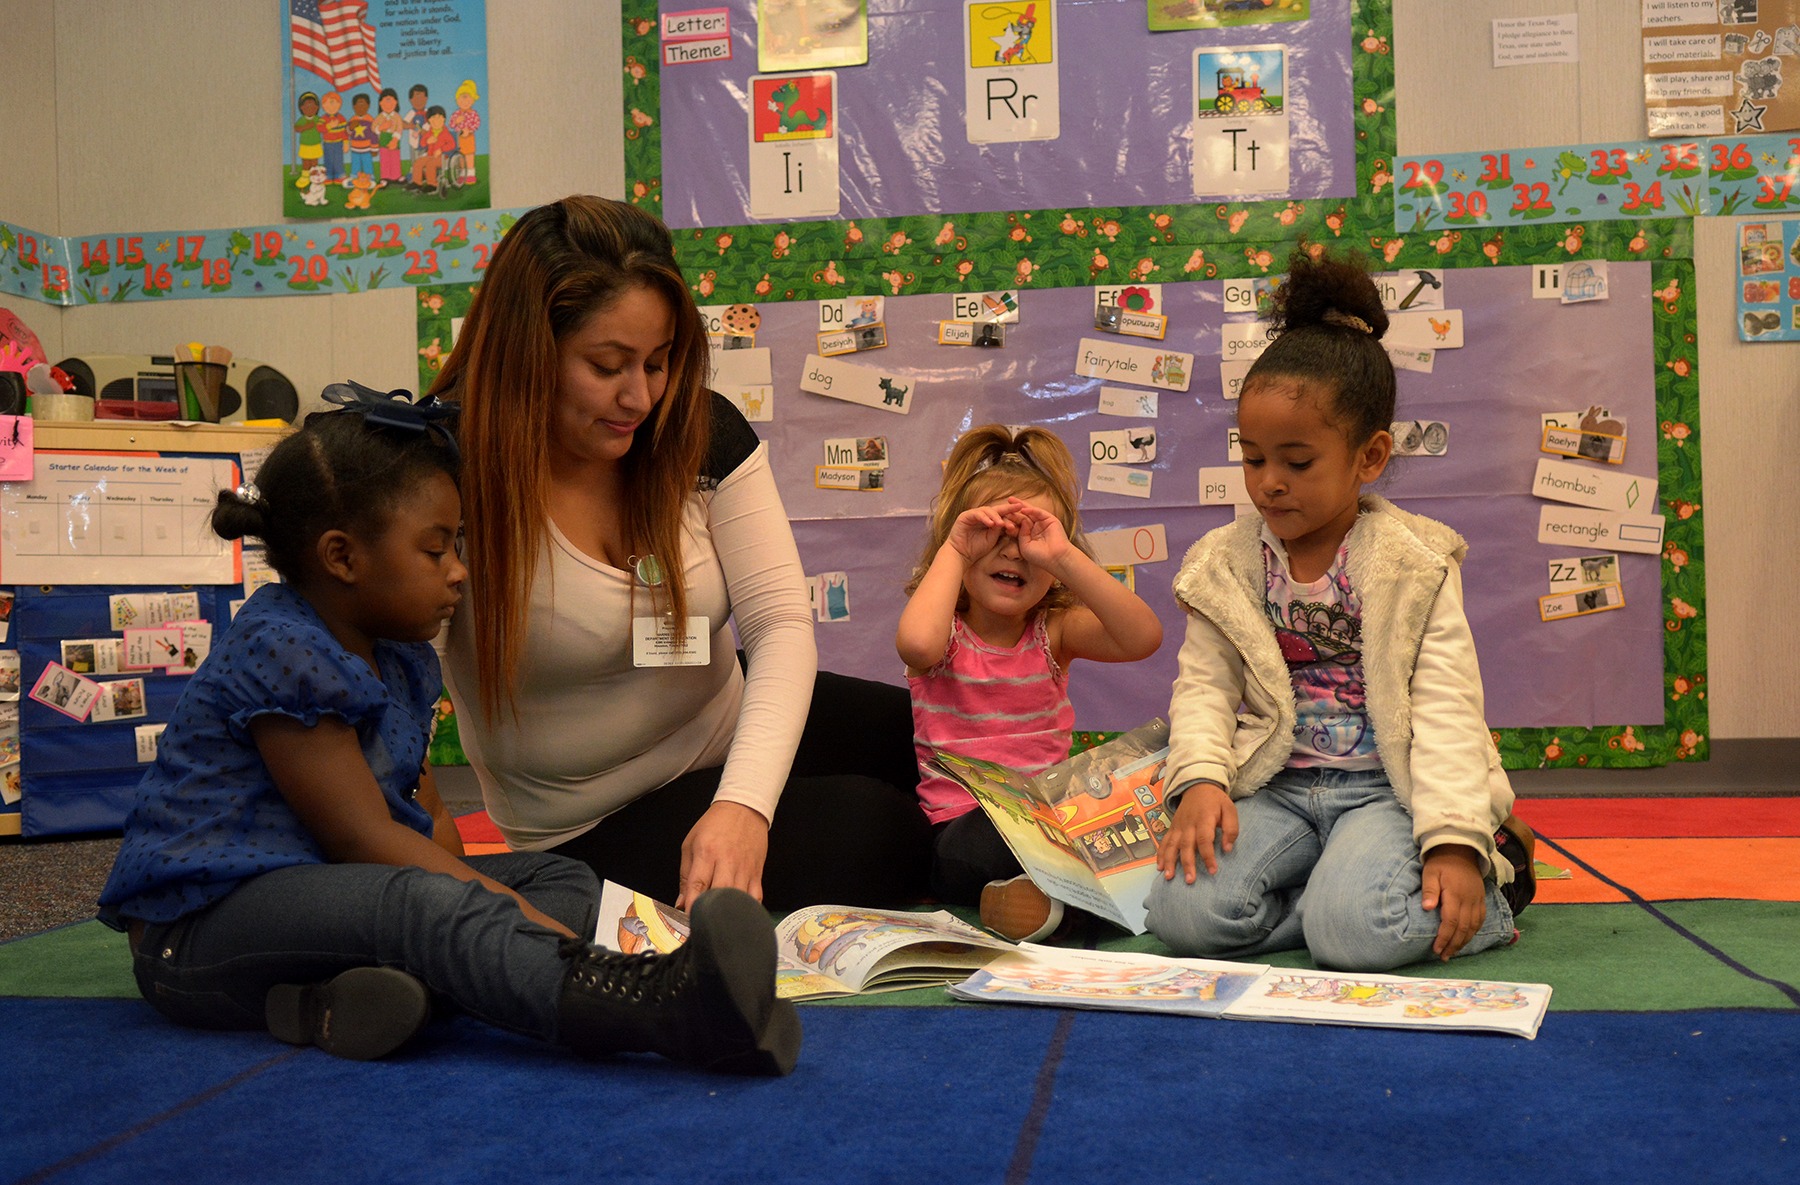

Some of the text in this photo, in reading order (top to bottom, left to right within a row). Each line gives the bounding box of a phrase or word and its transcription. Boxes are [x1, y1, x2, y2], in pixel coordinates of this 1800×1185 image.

[398, 7, 419, 15] which
[1651, 2, 1666, 10] will
[1667, 1, 1689, 9] listen
[1701, 0, 1714, 8] my
[395, 18, 418, 26] nation
[420, 16, 441, 25] under
[667, 17, 725, 34] Letter:
[1647, 15, 1684, 23] teachers.
[400, 37, 442, 47] with liberty
[1501, 32, 1521, 40] pledge
[1669, 38, 1687, 46] take
[387, 49, 402, 59] and
[402, 50, 427, 60] justice
[428, 47, 439, 56] for
[667, 45, 727, 61] Theme:
[1649, 50, 1716, 60] school materials.
[1670, 75, 1689, 84] play,
[1691, 74, 1713, 82] share
[987, 77, 1038, 120] Rr
[1683, 87, 1712, 95] friends.
[1700, 109, 1721, 118] good
[1222, 128, 1260, 171] Tt
[1661, 143, 1700, 172] 35
[1711, 143, 1753, 172] 36
[783, 152, 803, 193] Ii
[1402, 159, 1445, 188] 29
[1480, 153, 1510, 182] 31
[1590, 148, 1629, 177] 33
[1512, 182, 1553, 211] 32
[1623, 181, 1665, 210] 34
[1756, 174, 1796, 203] 37
[1447, 190, 1488, 218] 30
[329, 226, 360, 254] 21
[366, 222, 403, 249] 22
[432, 217, 469, 244] 24
[17, 232, 39, 265] 12
[81, 239, 111, 269] 14
[116, 236, 144, 264] 15
[176, 235, 207, 263] 17
[253, 230, 283, 260] 19
[202, 258, 232, 286] 18
[287, 254, 329, 283] 20
[404, 249, 439, 276] 23
[41, 263, 70, 292] 13
[143, 263, 173, 290] 16
[955, 296, 978, 318] Ee
[1225, 286, 1251, 306] Gg
[822, 304, 843, 323] Dd
[945, 329, 970, 340] Elijah
[1228, 339, 1267, 355] goose
[1084, 350, 1138, 374] fairytale
[808, 368, 834, 391] dog
[1091, 440, 1118, 461] Oo
[1548, 435, 1578, 448] Raelyn
[827, 445, 853, 465] Mm
[49, 463, 81, 471] Starter
[83, 464, 119, 472] Calendar
[122, 465, 135, 473] for
[138, 465, 151, 473] the
[180, 466, 189, 474] of
[820, 471, 856, 482] Madyson
[1205, 483, 1226, 499] pig
[1540, 472, 1597, 496] rhombus
[1545, 521, 1609, 543] rectangle
[1550, 563, 1577, 583] Zz
[1545, 603, 1563, 614] Zoe
